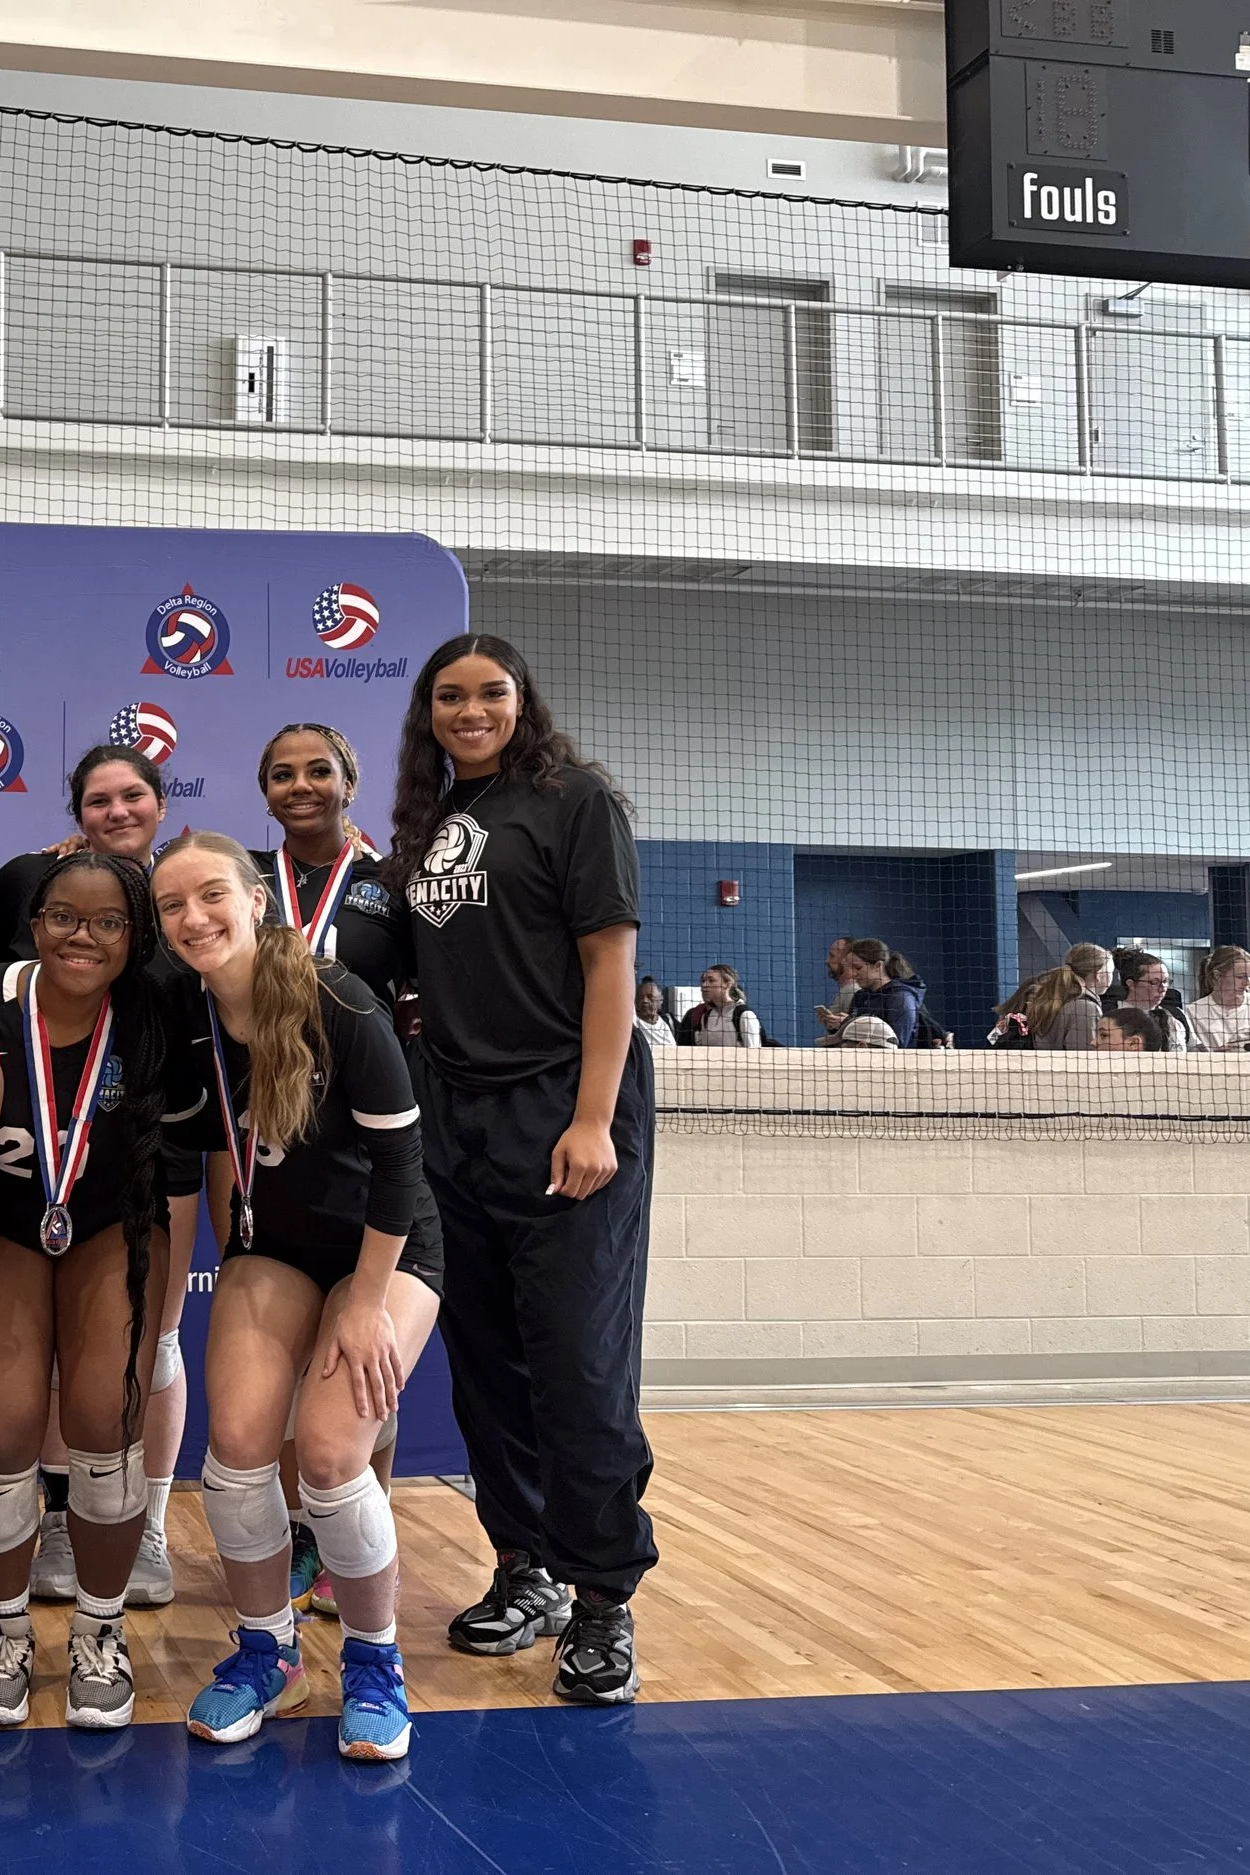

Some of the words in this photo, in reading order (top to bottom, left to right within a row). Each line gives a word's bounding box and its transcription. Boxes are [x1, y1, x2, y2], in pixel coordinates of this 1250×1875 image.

[1022, 171, 1117, 225] fouls
[157, 597, 183, 616] Delta
[184, 594, 218, 617] Region
[164, 660, 212, 679] Volleyball
[348, 895, 388, 916] TENACITY
